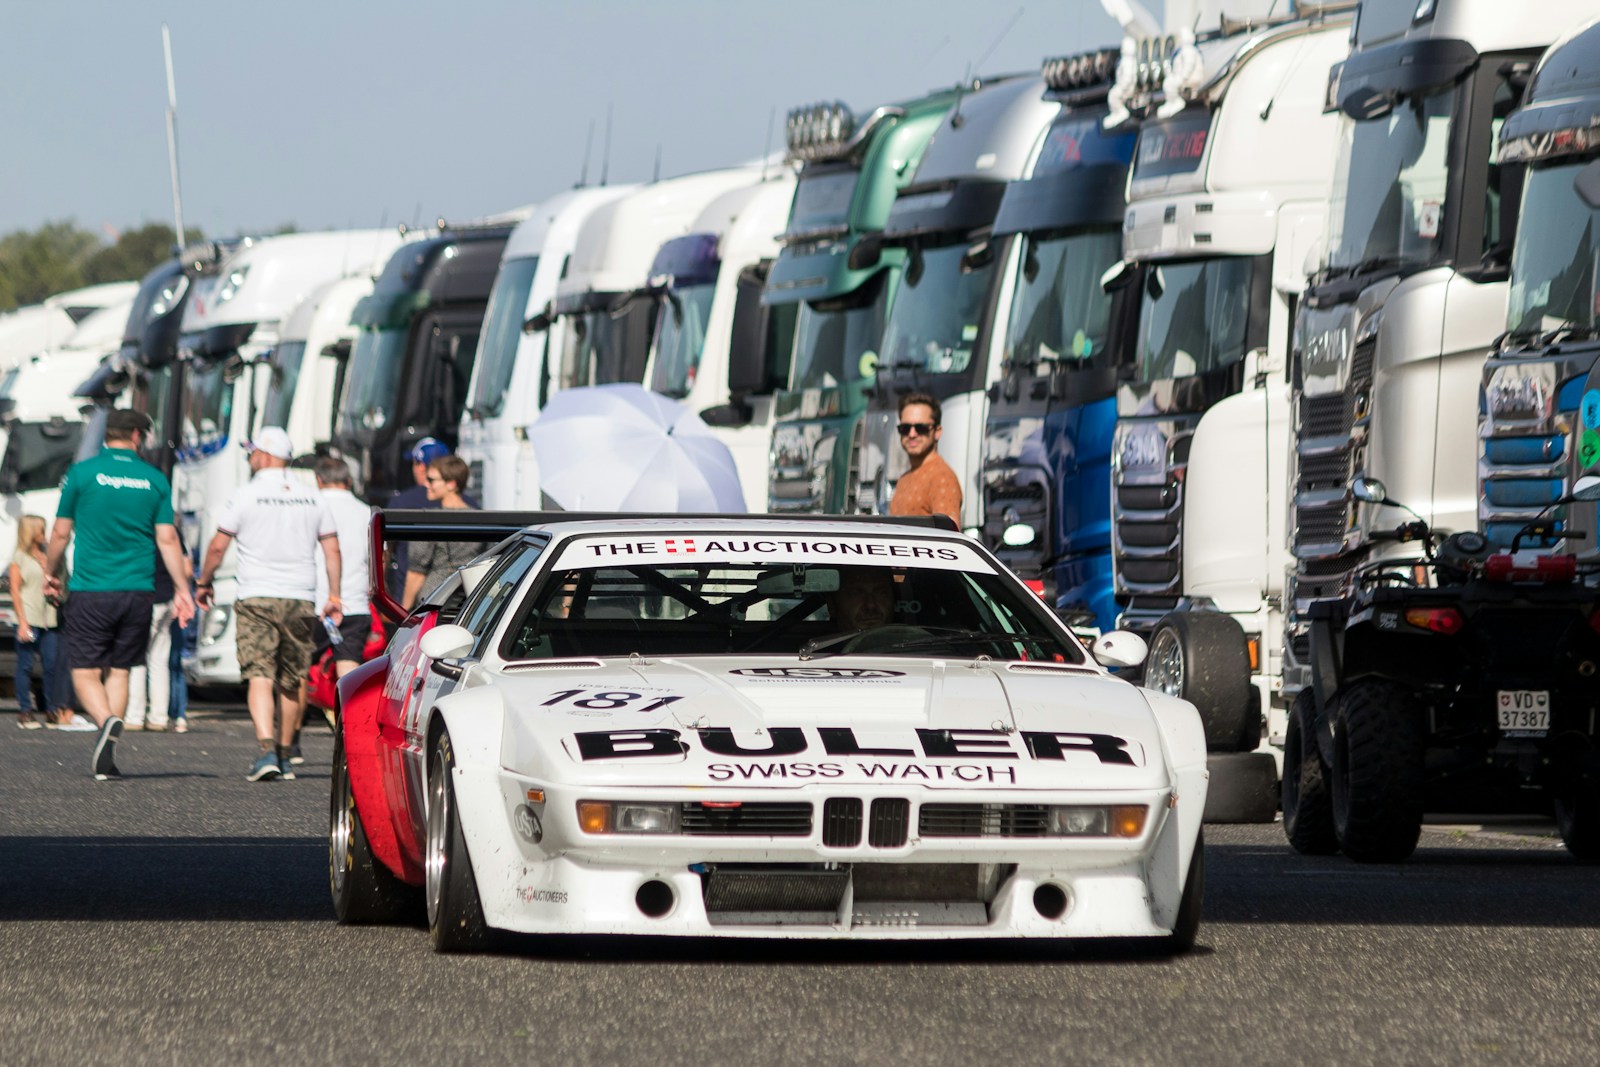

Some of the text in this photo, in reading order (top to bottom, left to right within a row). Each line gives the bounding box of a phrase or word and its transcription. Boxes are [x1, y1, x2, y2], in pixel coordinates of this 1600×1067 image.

[586, 541, 959, 561] THE AUCTIONEERS
[739, 668, 892, 678] LISTA
[540, 690, 686, 712] 181
[1513, 692, 1533, 709] VD
[1501, 711, 1547, 727] 37387
[573, 726, 1138, 767] BULER
[707, 763, 1016, 785] SWISS WATCH
[516, 887, 568, 904] THE AUCTIONEERS
